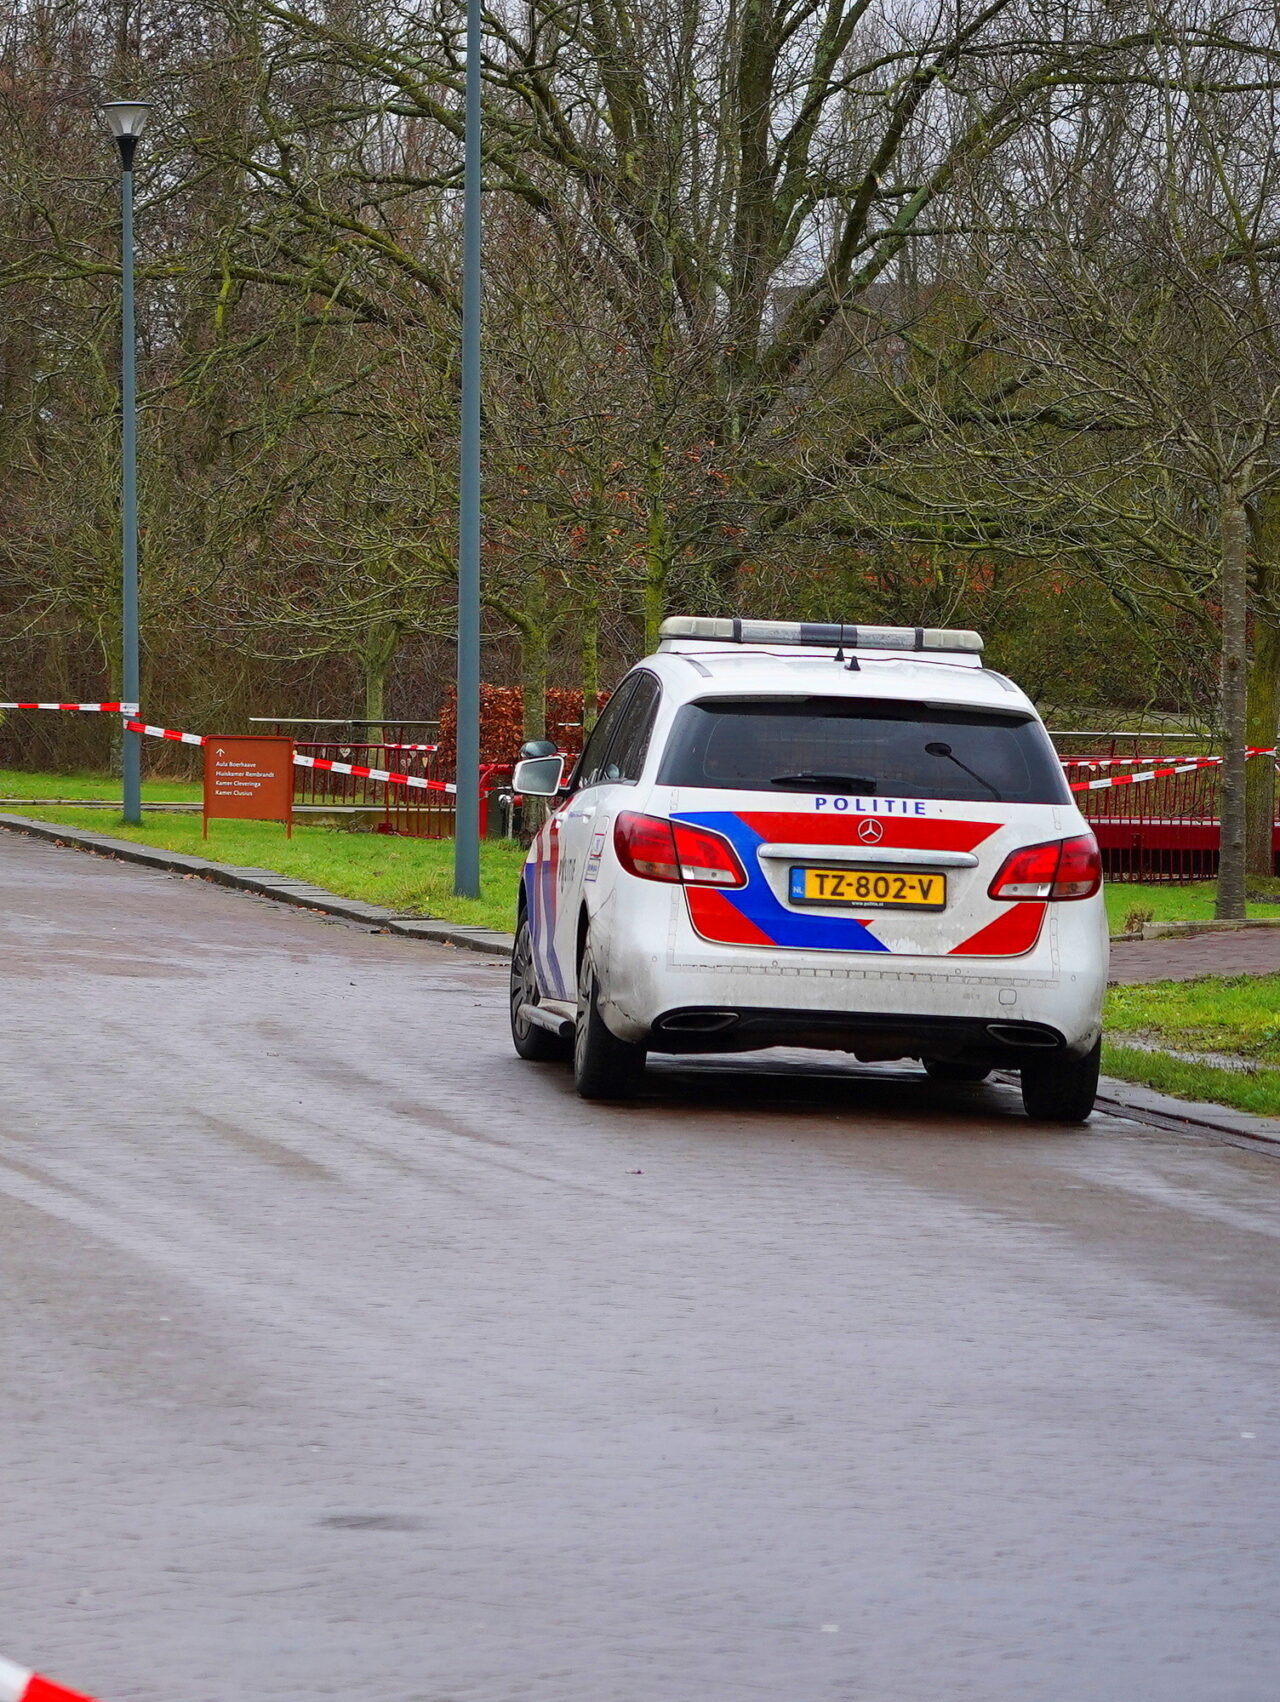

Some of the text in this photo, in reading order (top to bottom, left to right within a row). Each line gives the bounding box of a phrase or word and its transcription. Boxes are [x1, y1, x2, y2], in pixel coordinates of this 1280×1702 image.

[815, 797, 926, 815] POLITIE
[792, 886, 803, 894] NL
[815, 873, 933, 900] TZ-802-V
